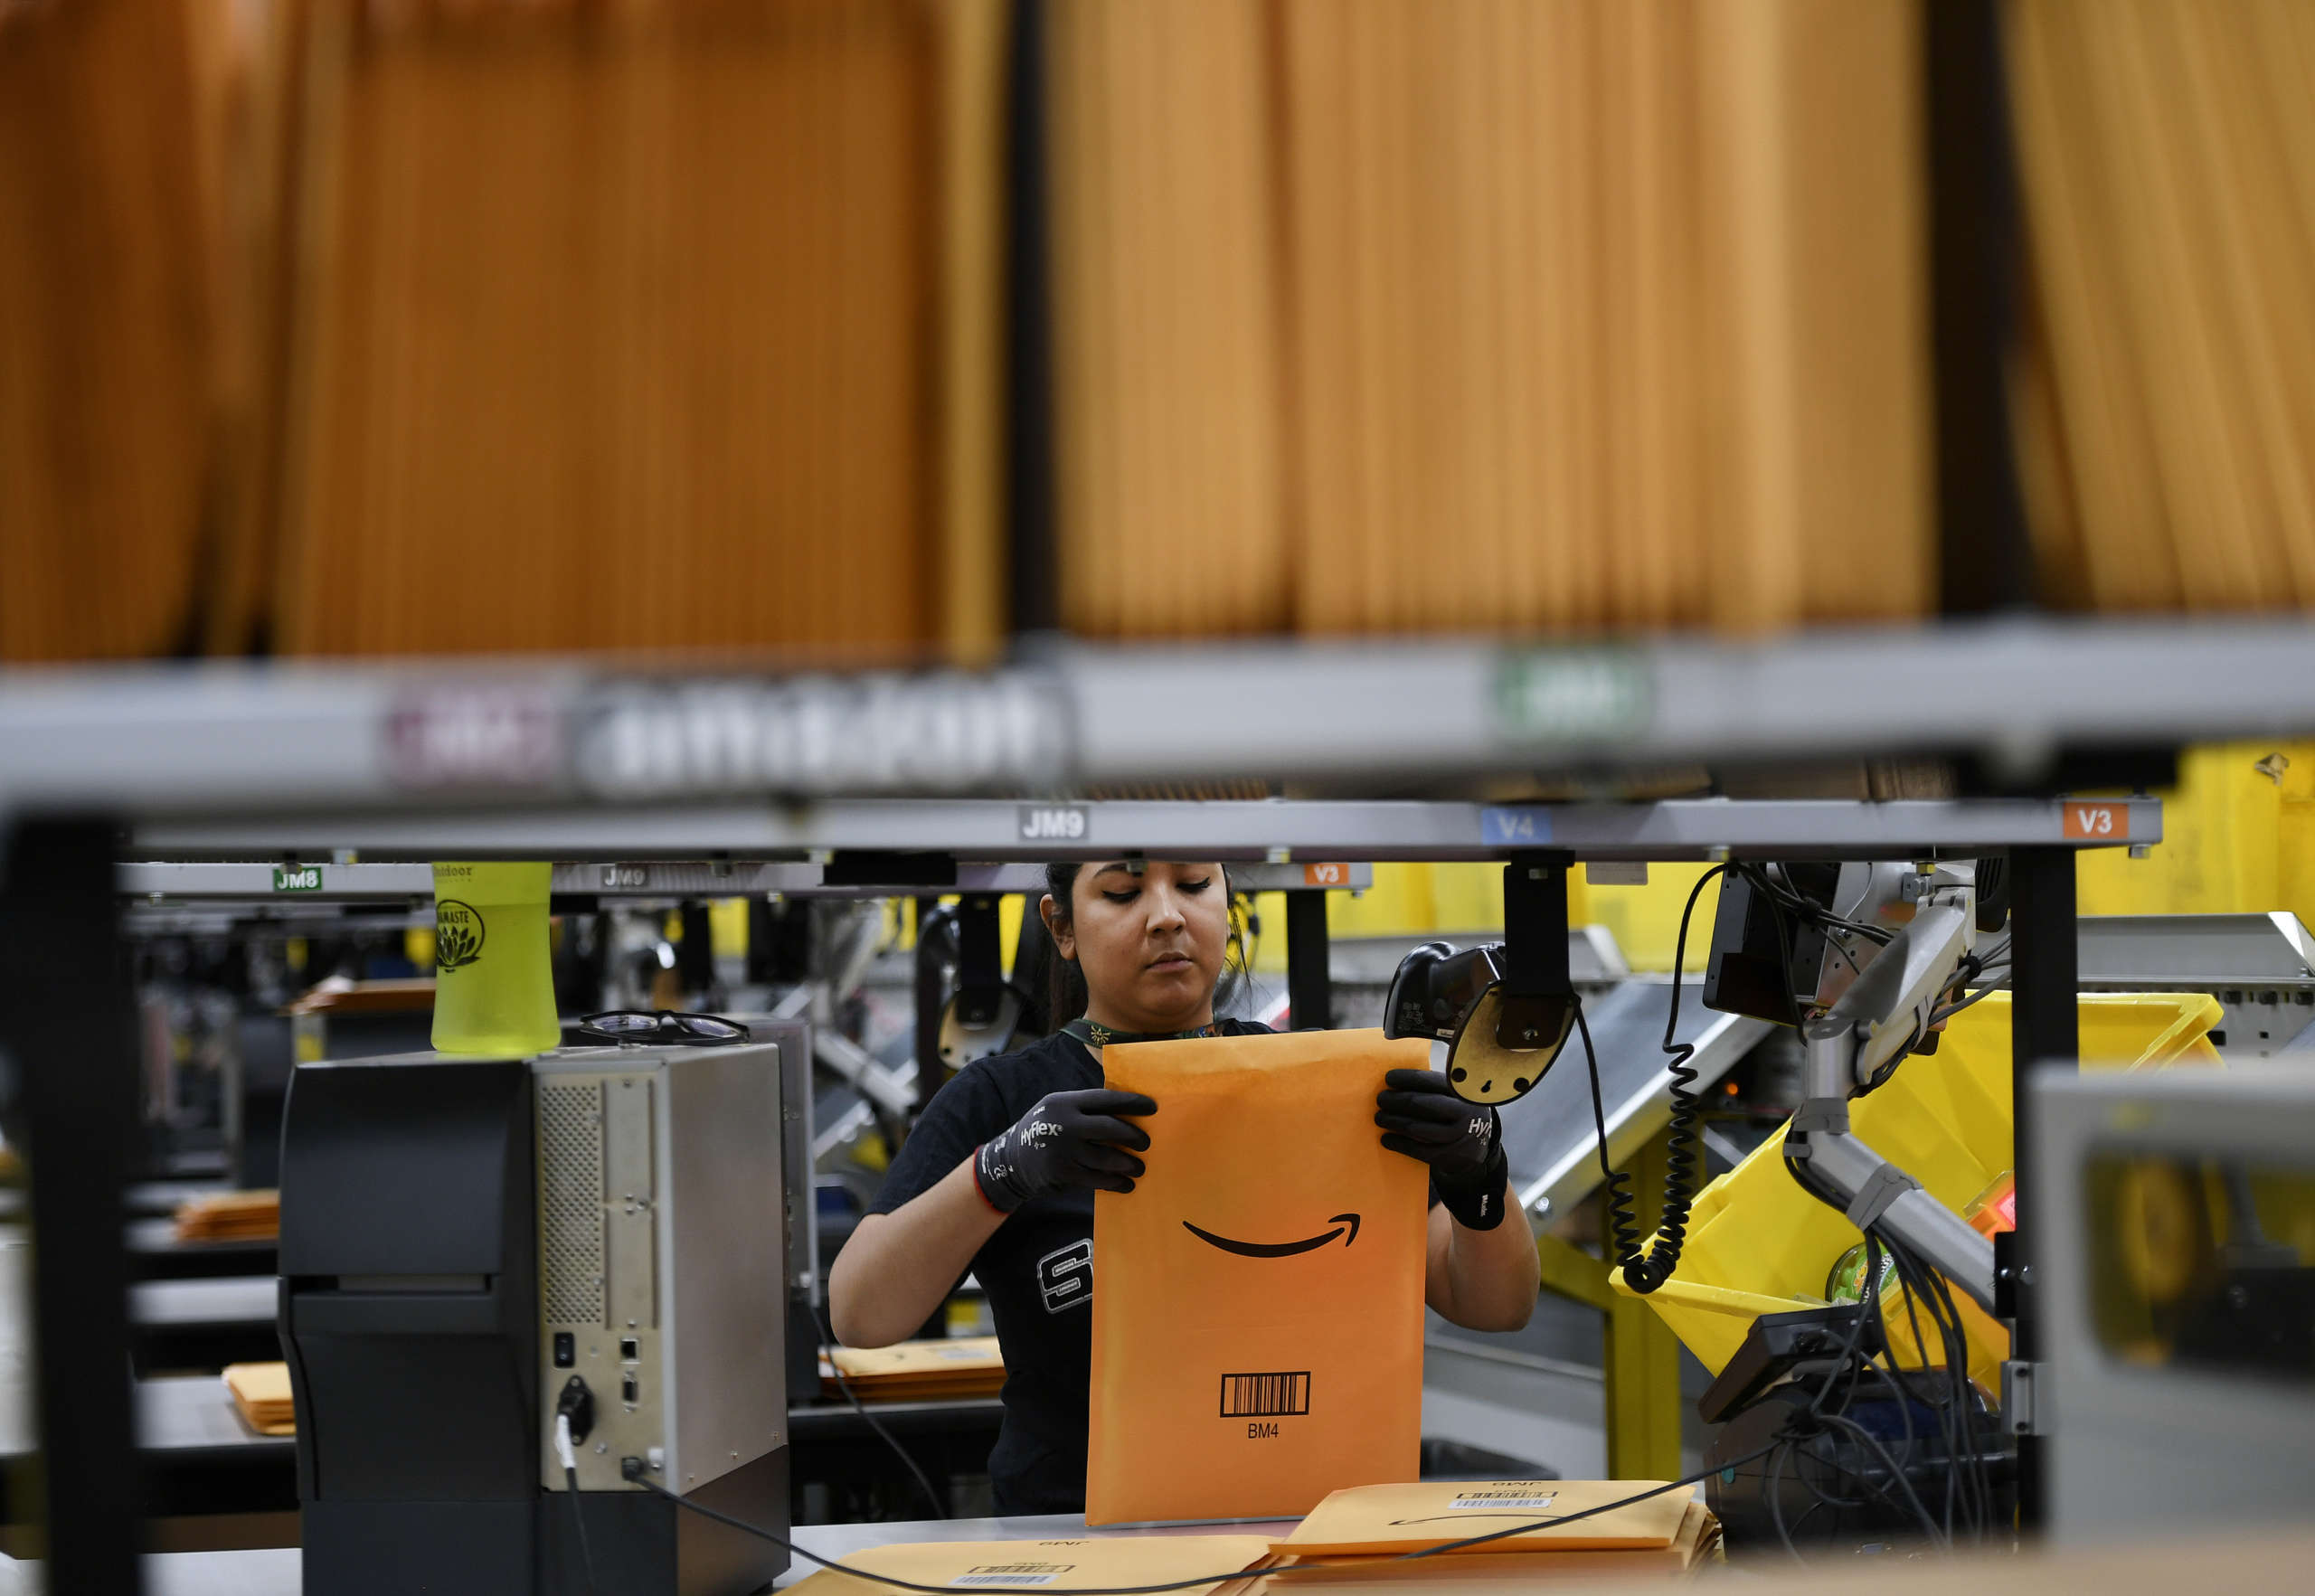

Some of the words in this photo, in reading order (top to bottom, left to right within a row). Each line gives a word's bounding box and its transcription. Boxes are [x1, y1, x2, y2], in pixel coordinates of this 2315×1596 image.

[1023, 810, 1084, 837] JM9
[1498, 814, 1533, 840] V4
[2077, 808, 2112, 834] V3
[278, 870, 318, 889] JM8
[605, 867, 645, 886] JM9
[1314, 865, 1339, 883] V3
[1248, 1422, 1279, 1439] BM4
